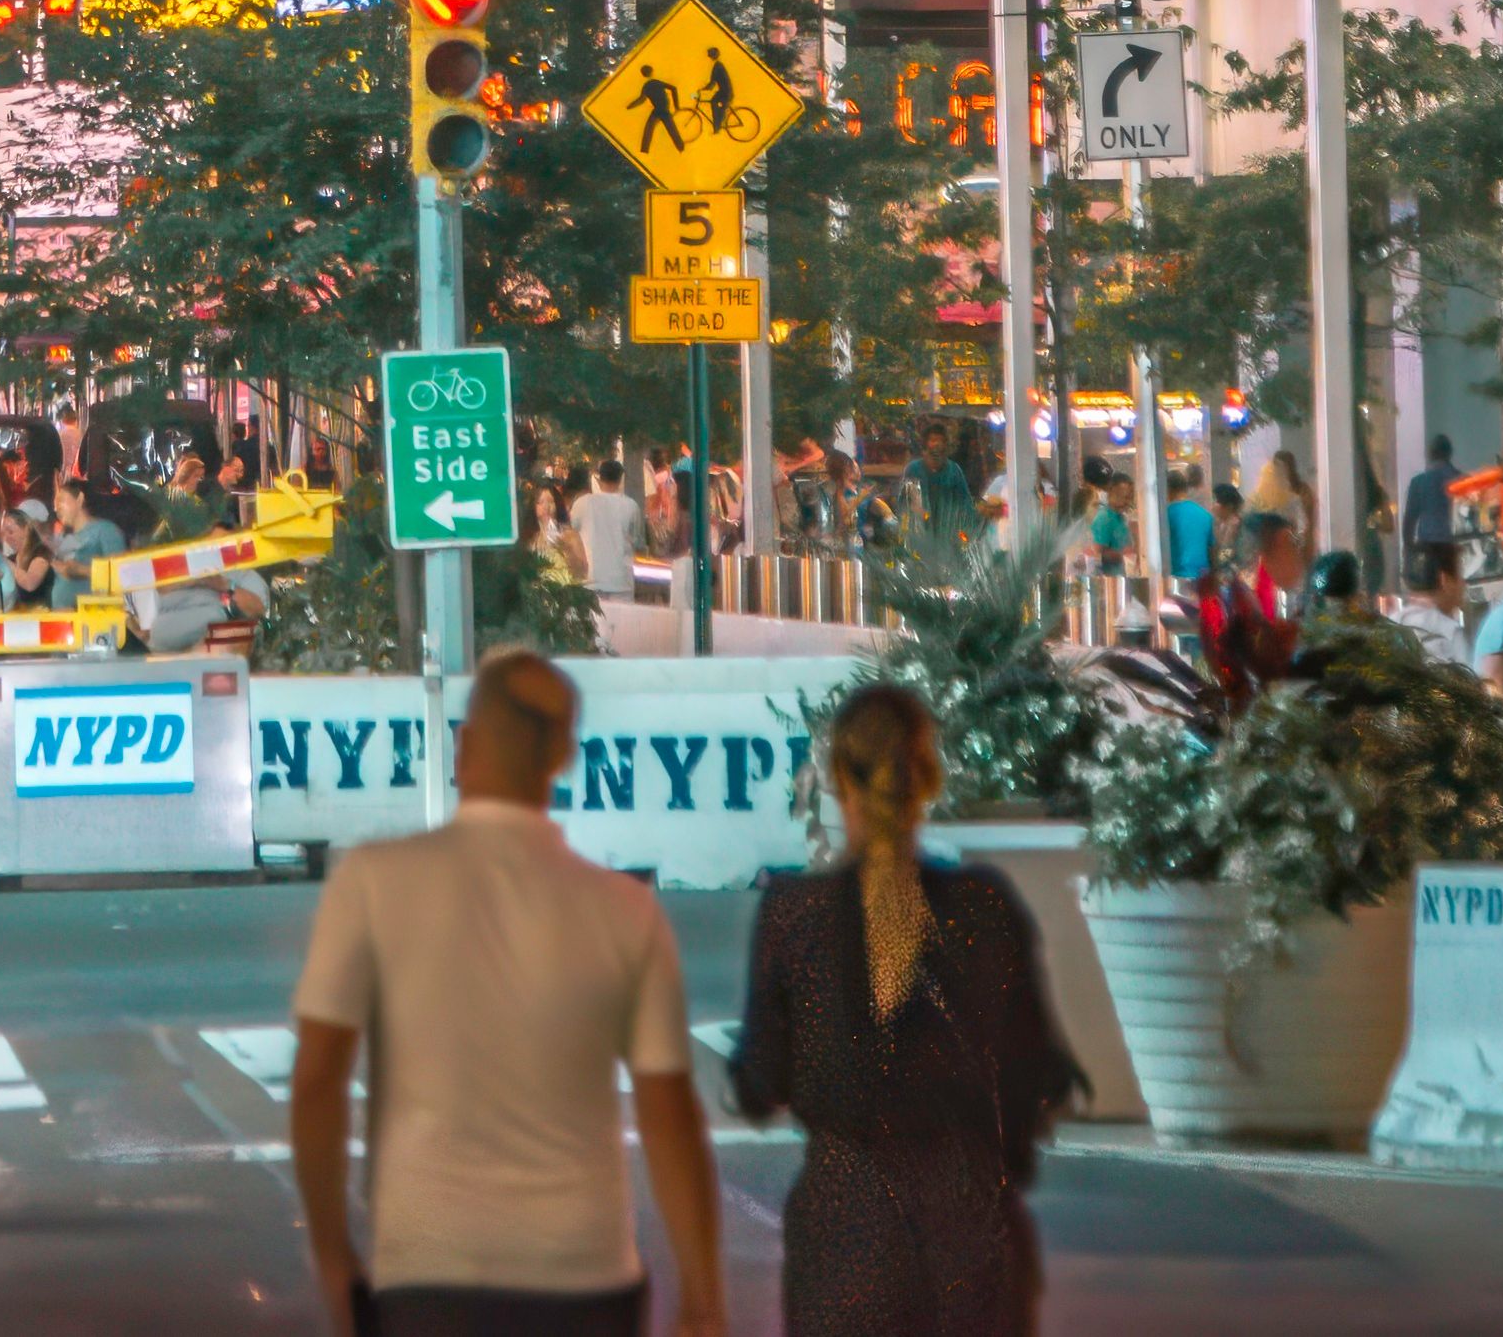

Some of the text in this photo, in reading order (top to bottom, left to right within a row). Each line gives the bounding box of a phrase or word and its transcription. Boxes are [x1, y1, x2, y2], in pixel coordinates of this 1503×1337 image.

[1100, 124, 1170, 150] ONLY
[678, 202, 712, 246] 5
[642, 284, 753, 308] SHARE THE
[669, 311, 725, 332] ROAD
[412, 424, 488, 451] East
[414, 456, 489, 483] Side
[25, 716, 183, 767] NYPD
[259, 720, 429, 789] NYP
